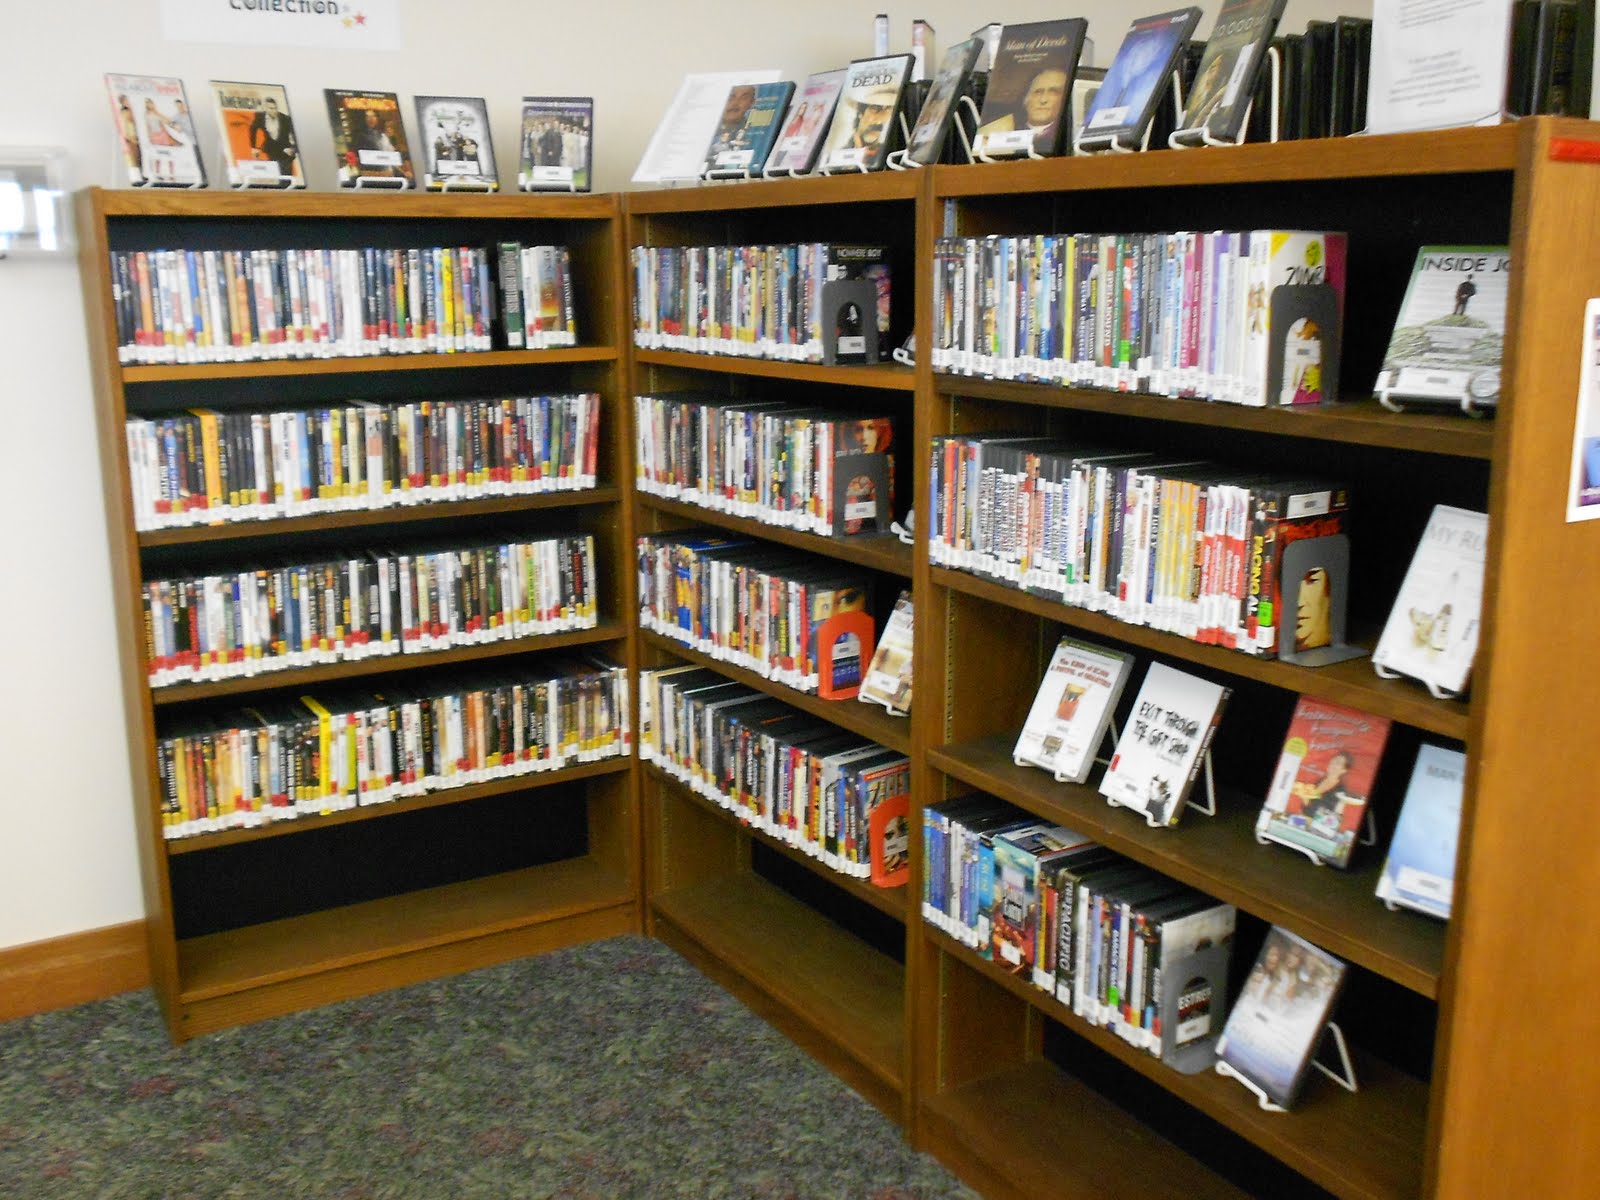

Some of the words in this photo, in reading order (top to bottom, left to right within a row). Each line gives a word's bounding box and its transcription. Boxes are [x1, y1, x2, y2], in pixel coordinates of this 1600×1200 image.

[229, 0, 339, 15] Collection
[852, 74, 893, 88] DEAD
[1421, 257, 1487, 272] INSIDE
[1492, 257, 1511, 272] JO
[1104, 272, 1113, 346] SPELLBOUND
[160, 465, 169, 500] BIUTIFU
[1062, 480, 1070, 516] PLUMBING
[1060, 525, 1069, 566] ELECTRICITY
[1251, 536, 1264, 595] PACINO
[309, 595, 317, 634] FRACTUR
[1140, 701, 1163, 720] EXIT
[1165, 710, 1200, 738] THROUGH
[1134, 720, 1149, 741] THE
[1149, 728, 1169, 746] GIFT
[1168, 738, 1190, 757] SHOP
[1064, 881, 1073, 902] THE
[1059, 902, 1072, 971] PACIFIC
